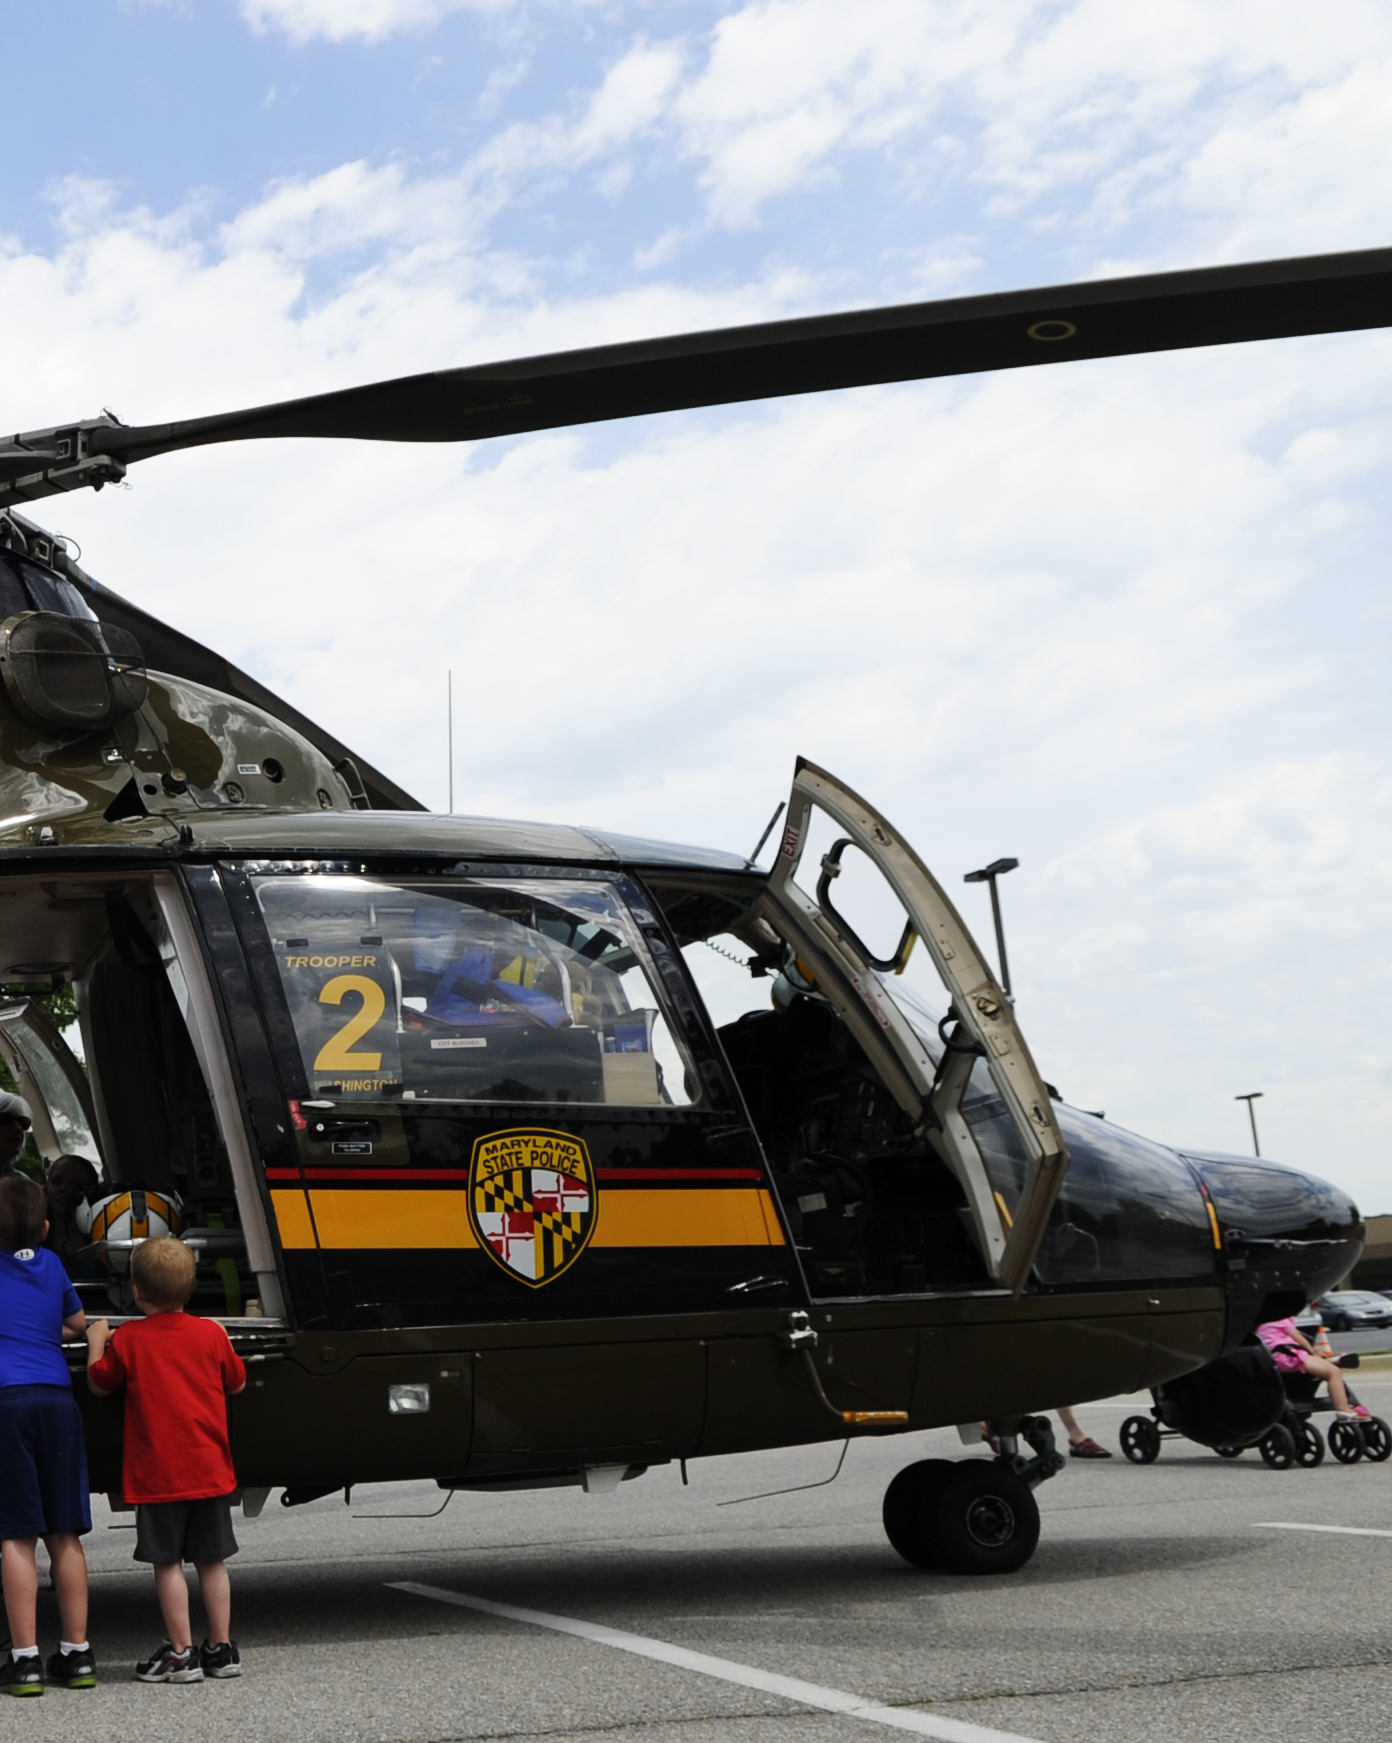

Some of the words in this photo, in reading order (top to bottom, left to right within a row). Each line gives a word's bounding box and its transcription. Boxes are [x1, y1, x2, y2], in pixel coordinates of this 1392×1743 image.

[783, 827, 799, 857] EXIT
[284, 955, 377, 968] TROOPER
[313, 974, 386, 1071] 2
[484, 1138, 578, 1157] MARYLAND
[482, 1151, 525, 1175] STATE
[530, 1150, 581, 1176] POLICE
